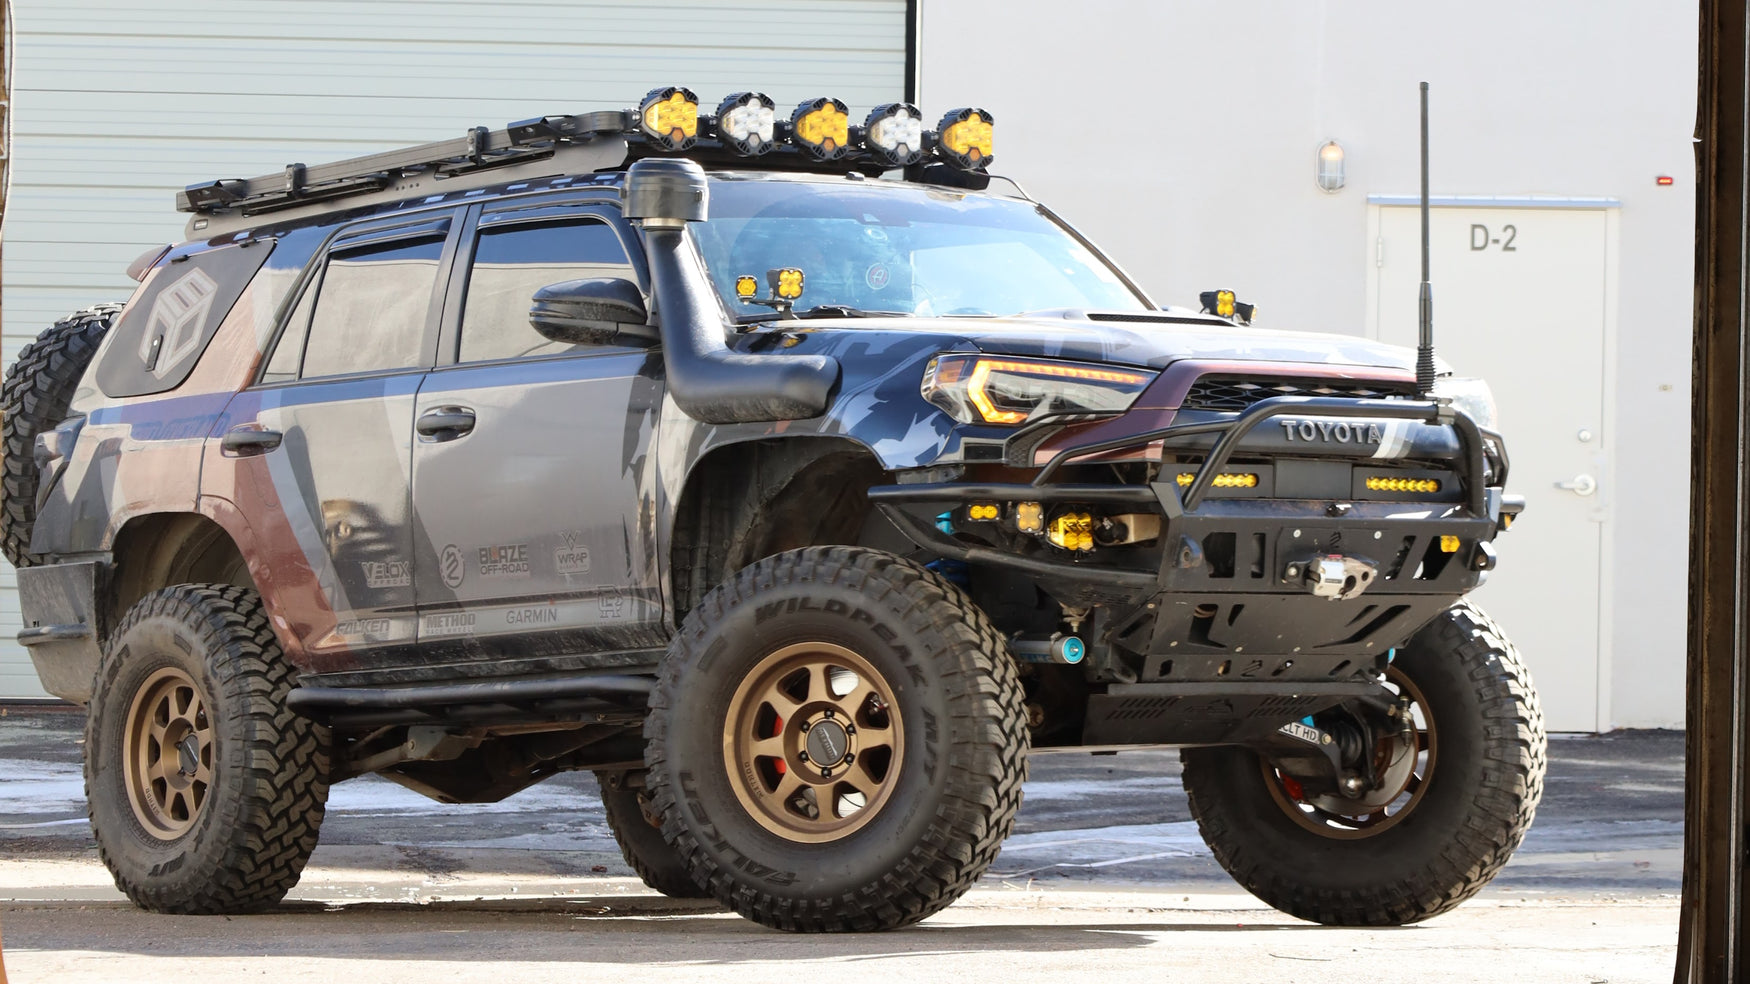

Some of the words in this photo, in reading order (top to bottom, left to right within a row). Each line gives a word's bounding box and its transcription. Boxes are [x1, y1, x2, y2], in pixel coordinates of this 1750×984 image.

[1470, 224, 1517, 252] D-2
[1280, 419, 1383, 444] TOYOTA
[478, 544, 529, 565] BLAZE
[557, 552, 588, 565] WRAP
[361, 561, 409, 580] VELOX
[479, 563, 529, 576] OFF-ROAD
[426, 613, 476, 629] METHOD
[506, 608, 558, 625] GARMIN
[336, 619, 390, 635] FALKEN
[755, 597, 929, 688] WILDPEAK
[1302, 728, 1317, 741] HD
